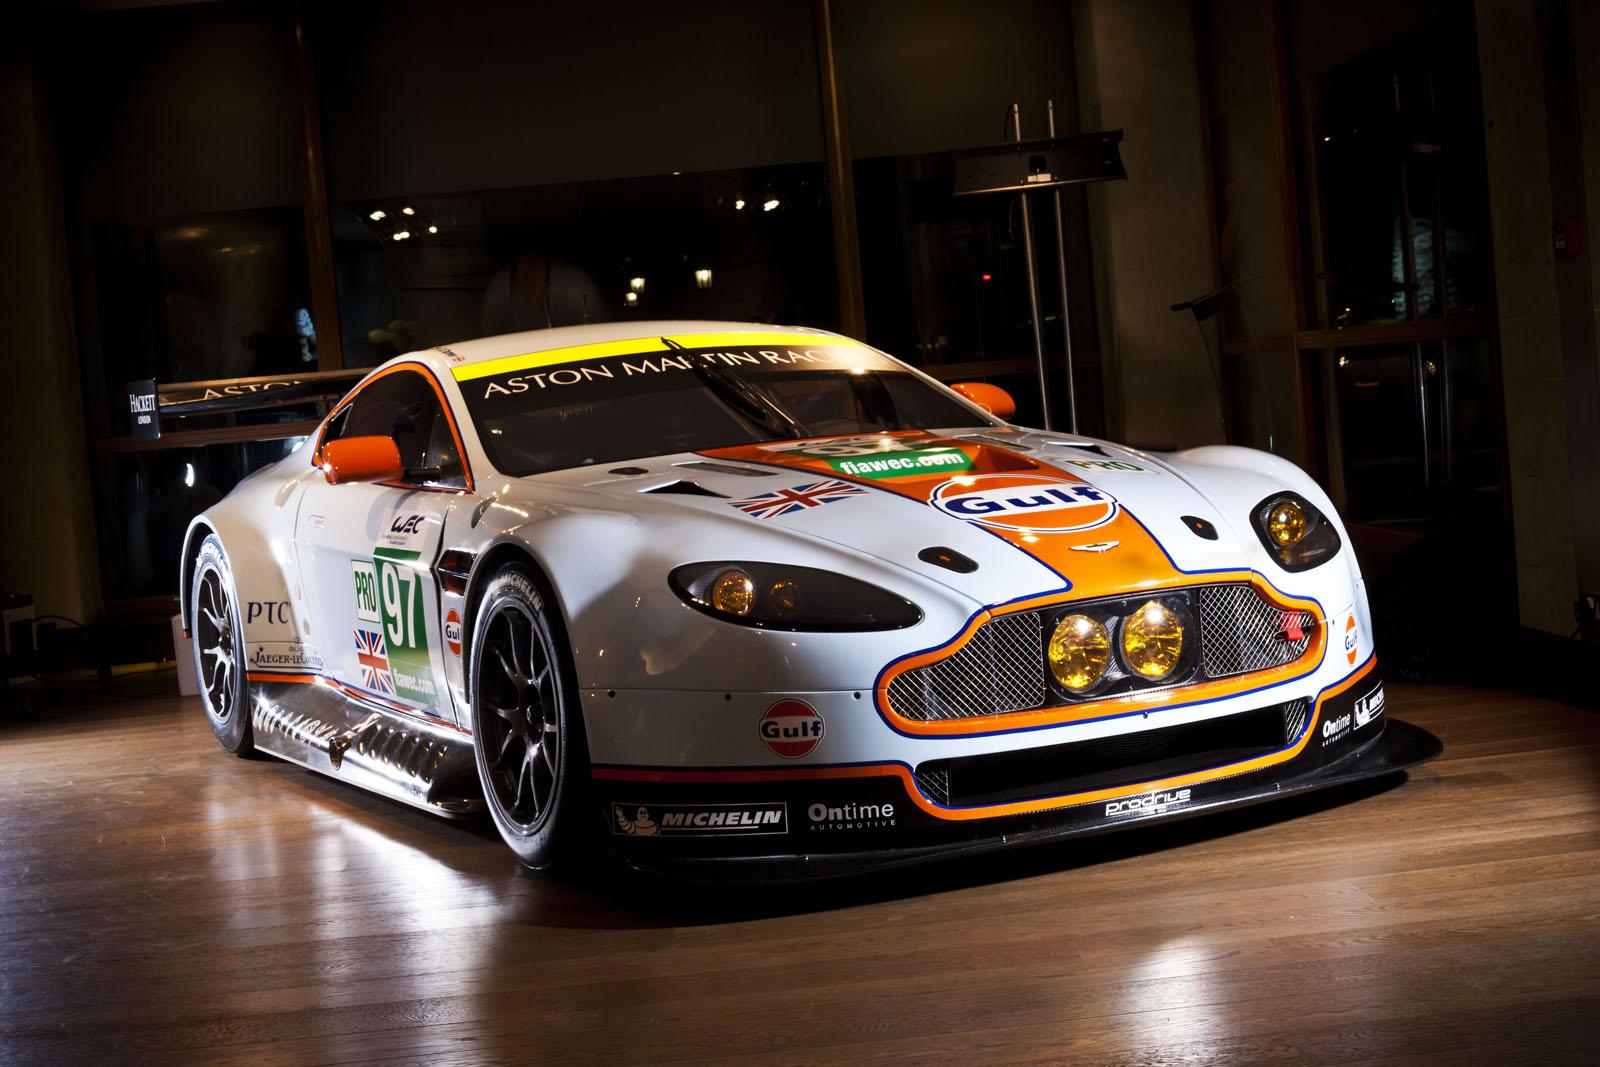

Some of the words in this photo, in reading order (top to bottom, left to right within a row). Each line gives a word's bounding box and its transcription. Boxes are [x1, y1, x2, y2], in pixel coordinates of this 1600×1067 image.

[484, 367, 614, 399] ASTON
[129, 394, 155, 412] HACKETT
[840, 453, 965, 476] fiawec.com
[944, 486, 1105, 515] Gulf
[391, 515, 425, 534] WEC
[354, 571, 376, 612] PRO
[247, 601, 289, 624] PTC
[382, 562, 416, 649] 97
[445, 625, 461, 640] Gul
[1345, 630, 1358, 650] Gulf
[761, 720, 822, 738] Gulf
[1322, 713, 1351, 737] Ontime
[808, 803, 894, 821] Ontime
[1105, 789, 1191, 816] prodrive
[662, 810, 782, 826] MICHELIN
[810, 820, 896, 831] AUTOMOTIVE
